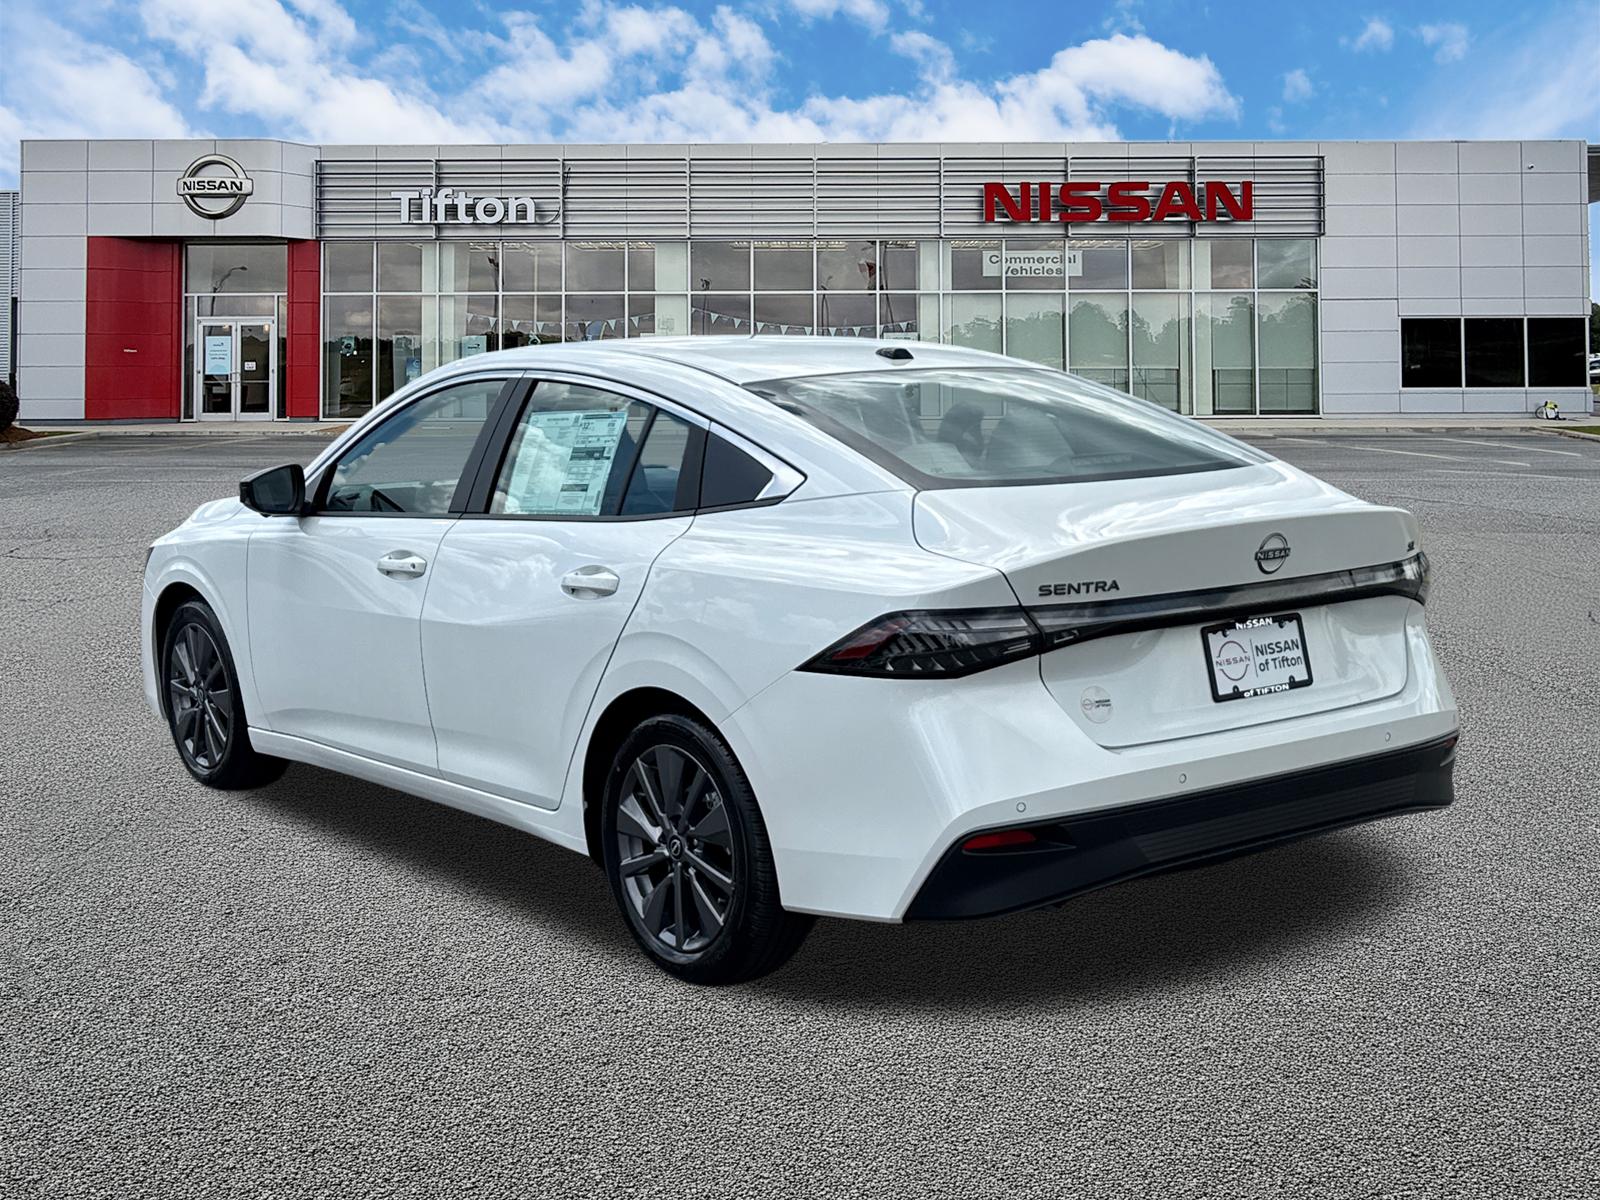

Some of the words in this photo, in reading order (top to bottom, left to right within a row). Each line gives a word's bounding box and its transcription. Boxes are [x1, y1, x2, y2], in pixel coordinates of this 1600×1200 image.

[183, 180, 243, 192] NISSAN
[391, 187, 536, 224] Tifton
[983, 181, 1254, 222] NISSAN
[1256, 548, 1290, 559] NISSAN
[1038, 579, 1120, 597] SENTRA
[1235, 617, 1273, 630] NISSAN
[1255, 638, 1300, 657] NISSAN
[1215, 655, 1251, 667] NISSAN
[1258, 660, 1269, 672] of
[1270, 655, 1303, 670] Tifton
[1243, 690, 1254, 698] of
[1255, 683, 1290, 696] TIFTON
